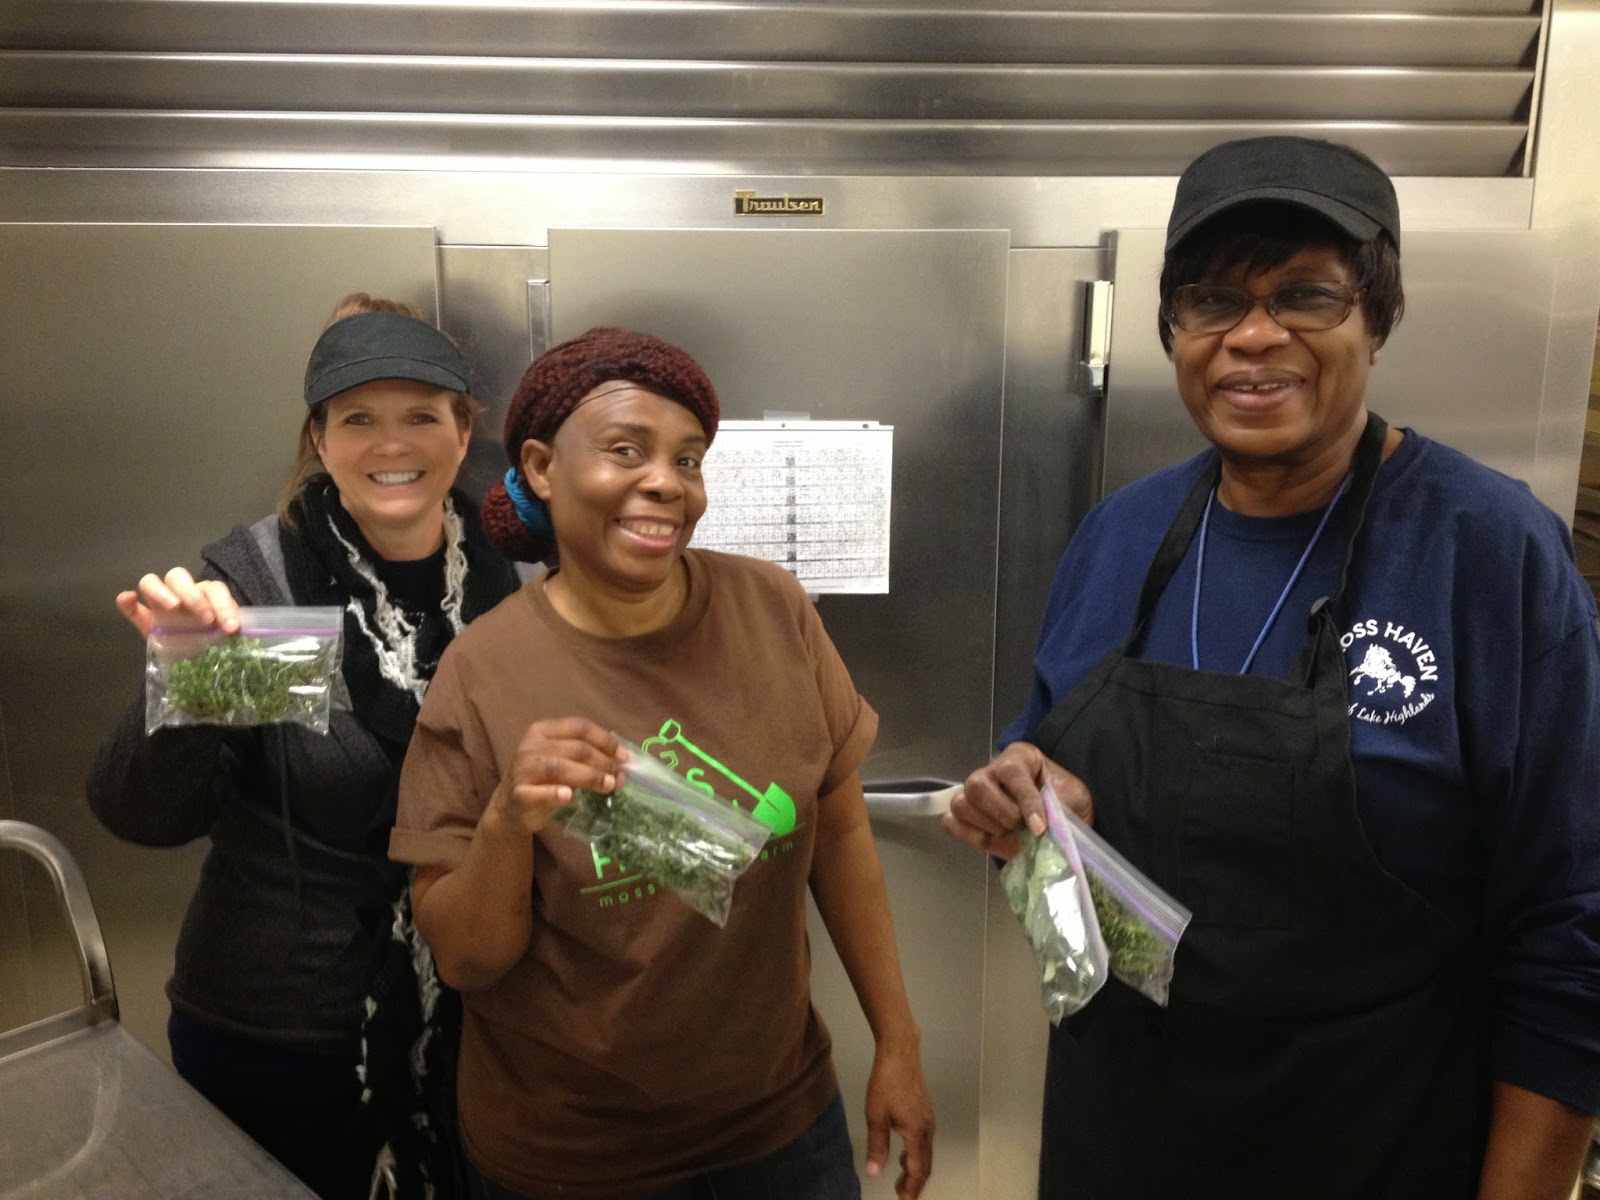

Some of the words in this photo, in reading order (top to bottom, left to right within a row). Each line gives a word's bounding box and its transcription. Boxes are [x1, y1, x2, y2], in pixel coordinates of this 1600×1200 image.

[735, 189, 822, 213] Traulsen
[1340, 619, 1379, 653] OSS
[1384, 621, 1438, 682] HAVEN
[1356, 707, 1382, 723] Lake
[1383, 693, 1435, 725] Highlands
[600, 883, 656, 908] moss
